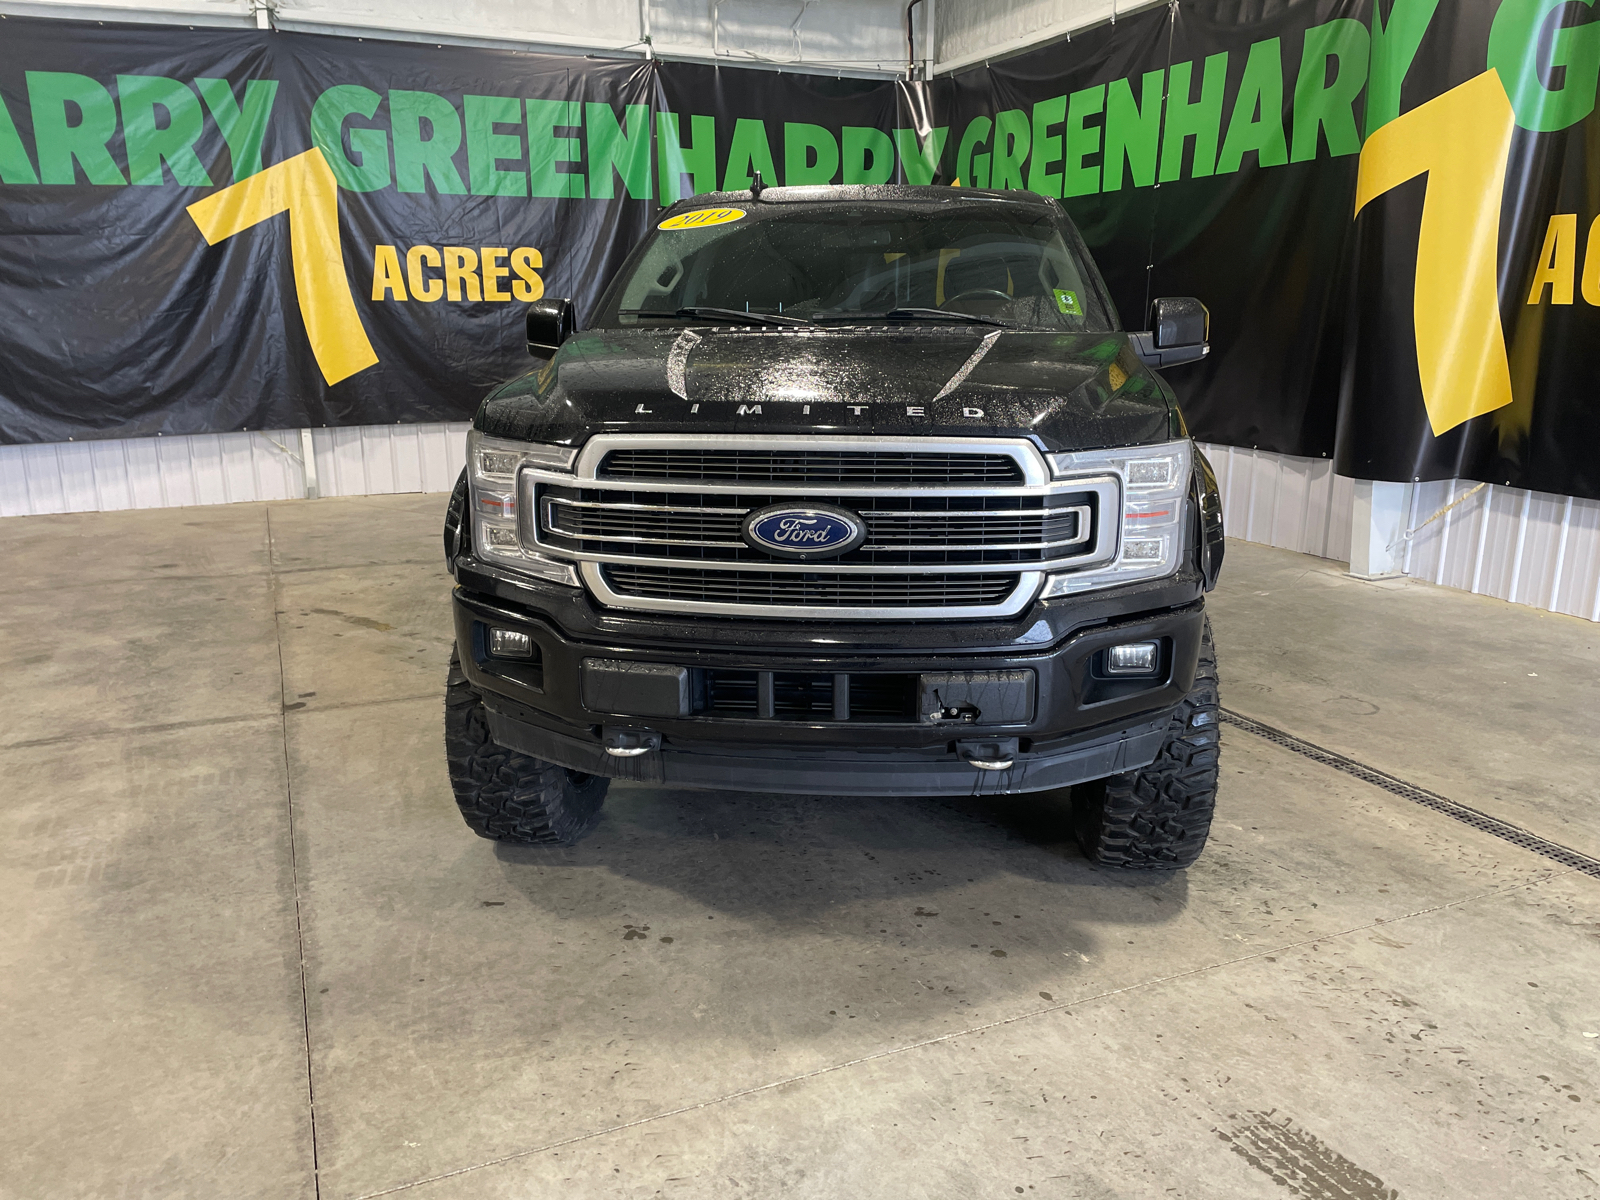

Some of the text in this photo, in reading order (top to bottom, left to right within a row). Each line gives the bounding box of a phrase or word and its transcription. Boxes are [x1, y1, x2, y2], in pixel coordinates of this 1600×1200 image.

[310, 84, 654, 200] GREEN
[668, 209, 733, 228] 2019
[371, 244, 545, 302] ACRES
[634, 402, 985, 418] LIMITED
[773, 517, 832, 542] Ford
